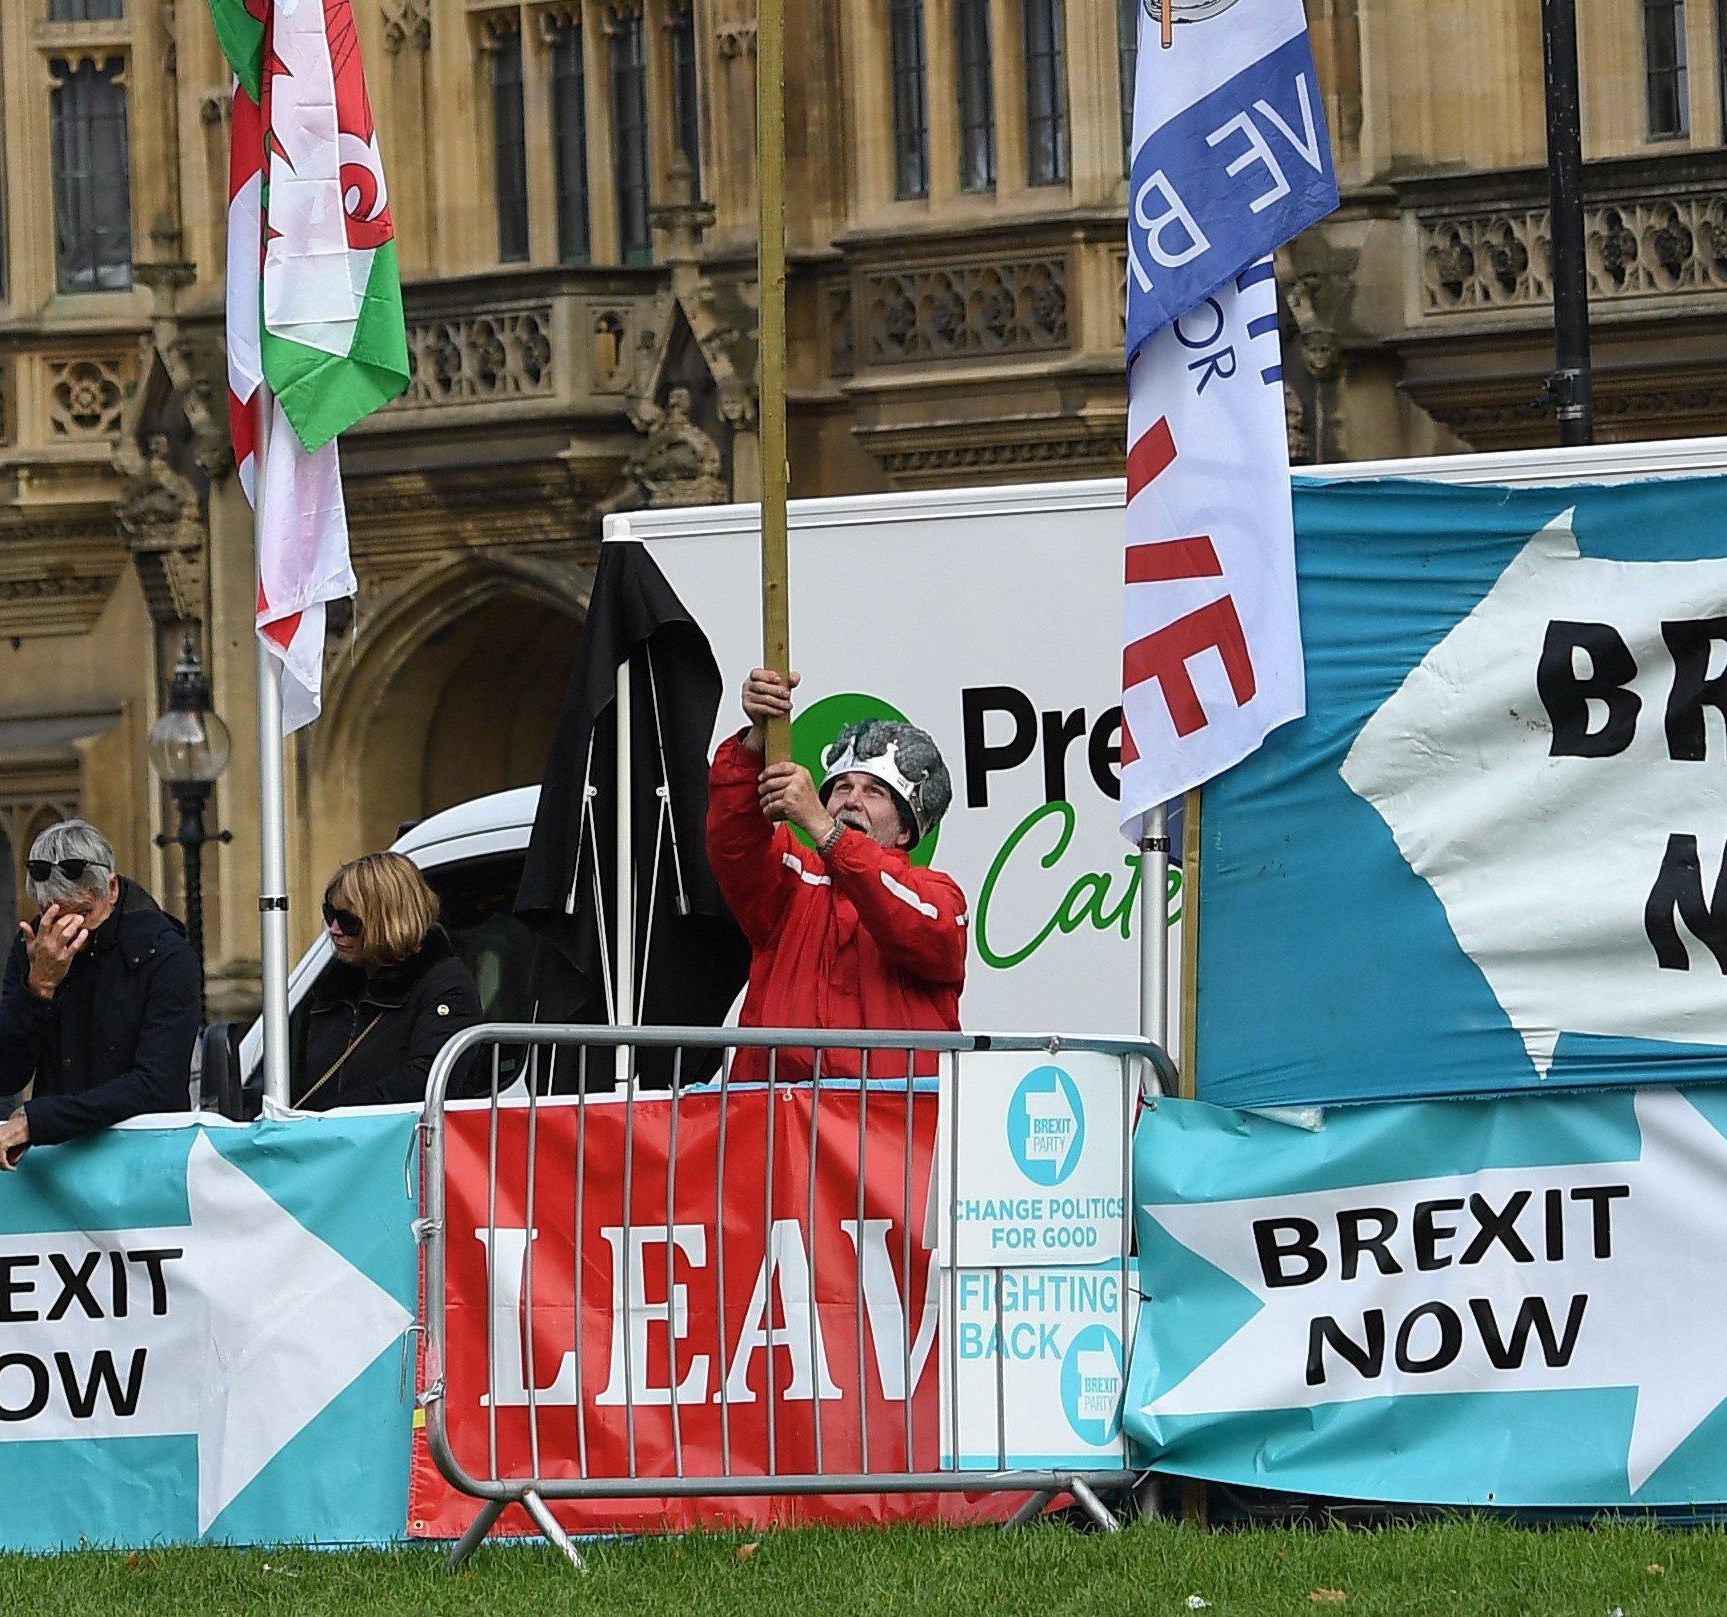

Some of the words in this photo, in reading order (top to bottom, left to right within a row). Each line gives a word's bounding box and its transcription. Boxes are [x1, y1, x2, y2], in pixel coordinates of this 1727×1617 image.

[1174, 298, 1238, 396] OR
[1034, 1117, 1071, 1134] BREXIT
[1034, 1136, 1065, 1152] PARTY
[1049, 1197, 1124, 1220] POLITICS
[991, 1227, 1036, 1249] FOR
[1042, 1226, 1098, 1248] GOOD
[1252, 1185, 1629, 1288] BREXIT
[960, 1274, 1118, 1313] FIGHTING
[474, 1218, 940, 1406] LEAV
[960, 1322, 1064, 1360] BACK
[1305, 1294, 1588, 1386] NOW
[1084, 1377, 1118, 1393] BREXIT
[1084, 1395, 1114, 1411] PARTY
